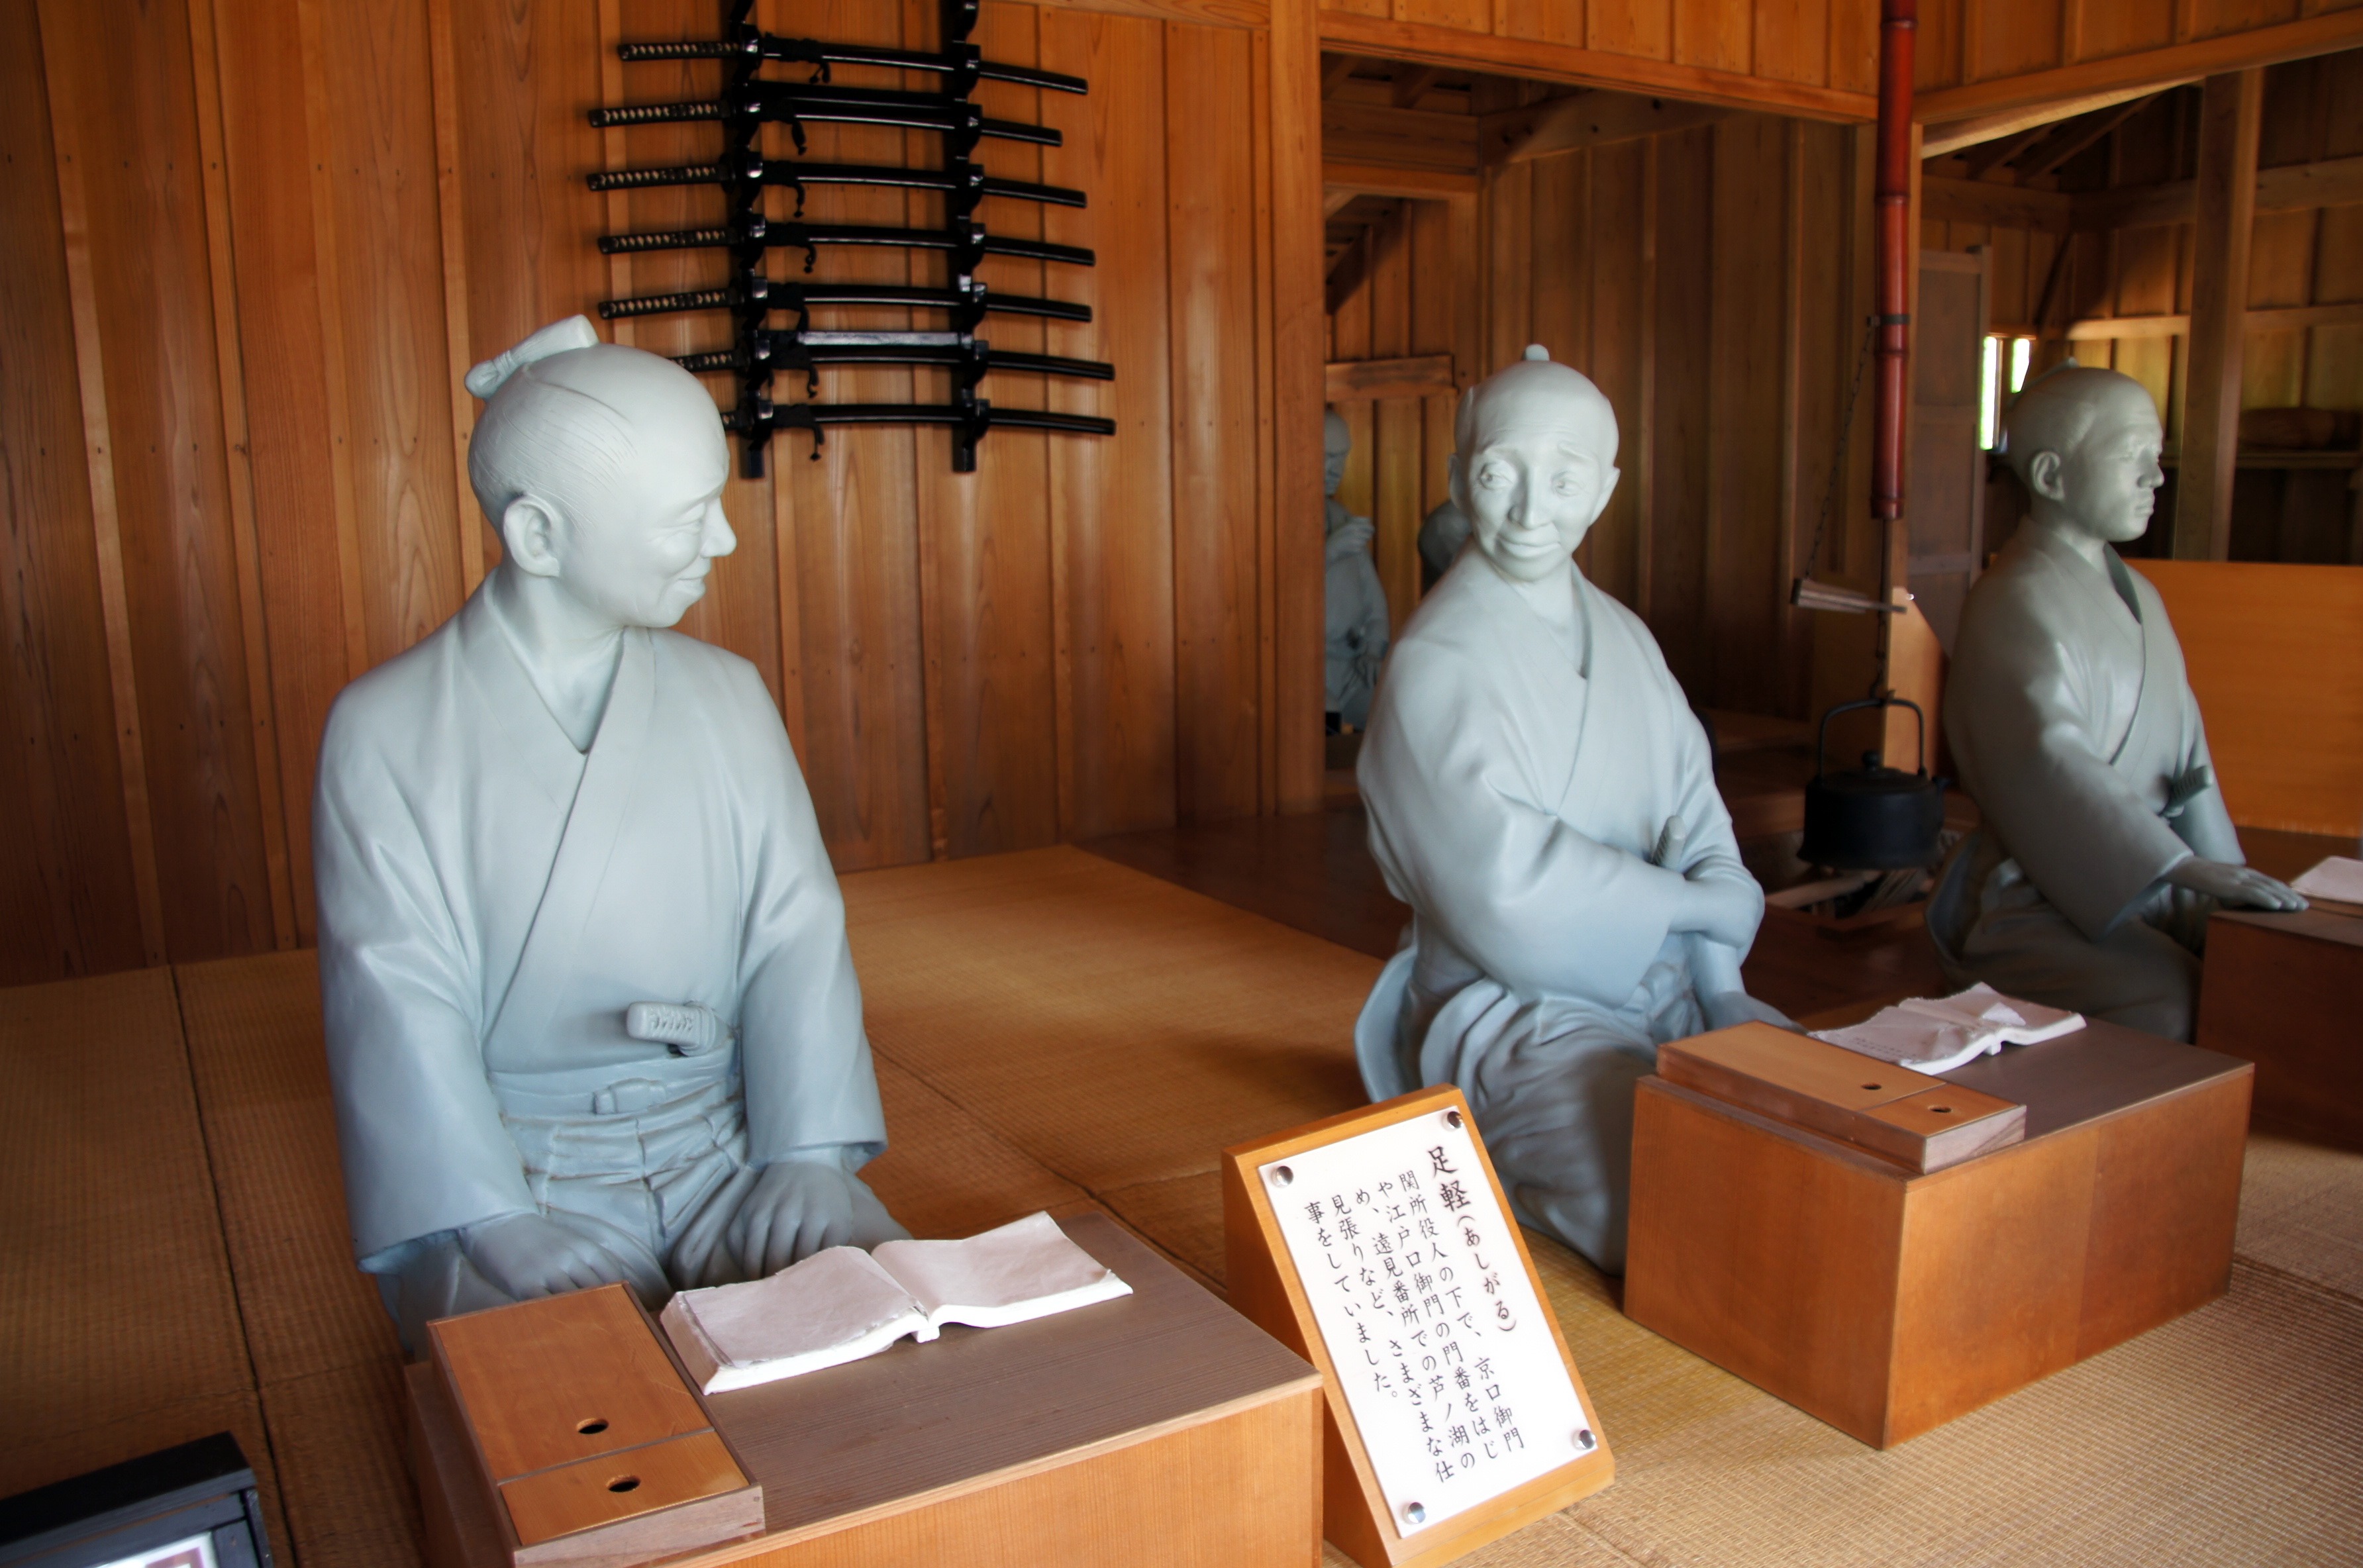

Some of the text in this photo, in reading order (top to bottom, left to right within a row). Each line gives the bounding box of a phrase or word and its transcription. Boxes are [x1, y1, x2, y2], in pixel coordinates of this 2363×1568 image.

[1305, 1201, 1398, 1398] 事をしていました。
[1331, 1195, 1454, 1482] 見張りなど、さまざまな仕
[1378, 1182, 1496, 1459] や江戸口御門の門番をはじ
